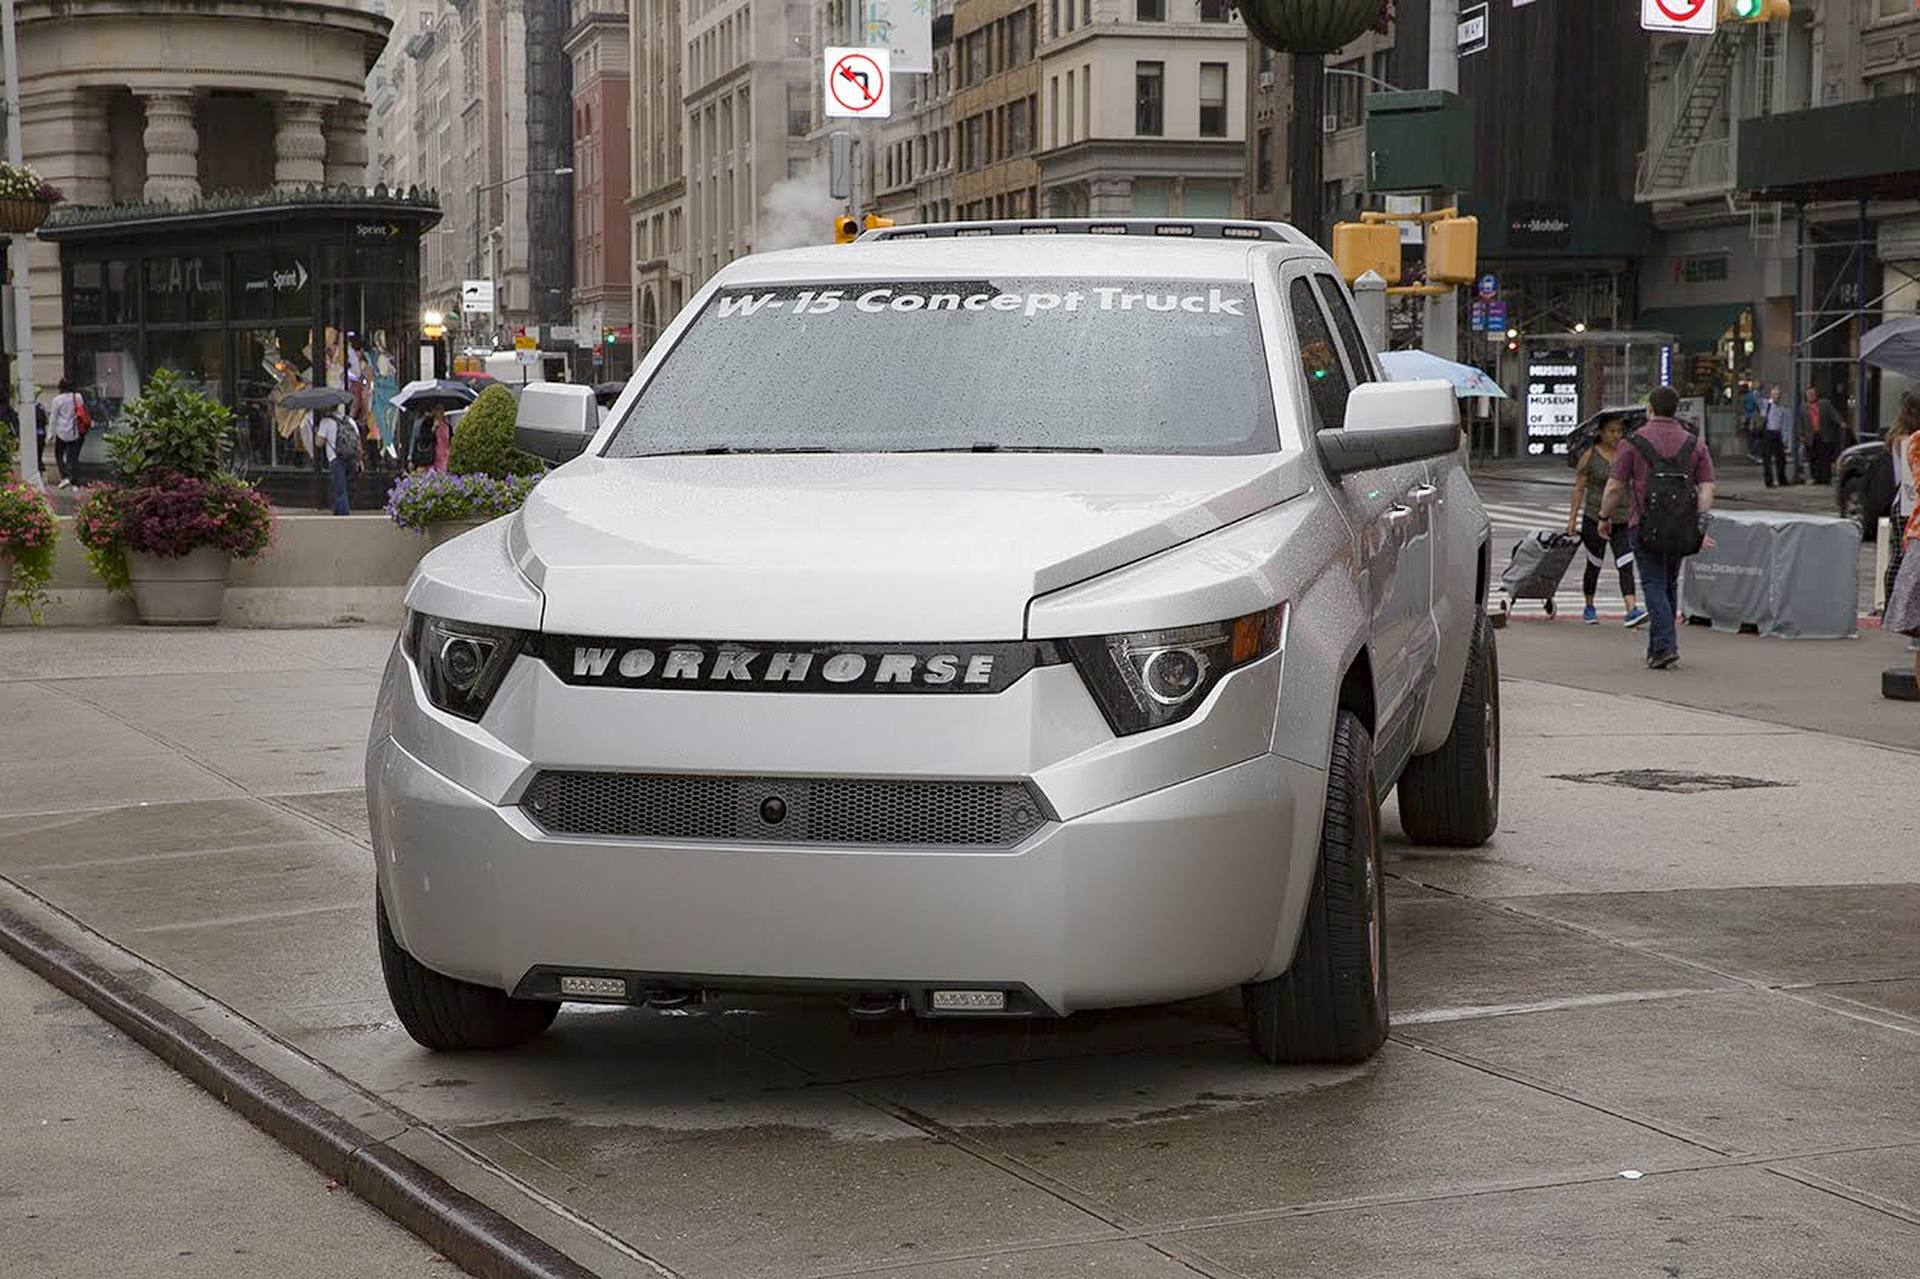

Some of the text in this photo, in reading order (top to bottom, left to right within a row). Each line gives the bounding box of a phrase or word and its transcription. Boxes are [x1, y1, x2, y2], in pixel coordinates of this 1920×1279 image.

[356, 224, 387, 236] Sprint
[273, 270, 297, 292] Sprint
[718, 288, 1244, 318] W-15 Concept Truck
[1529, 365, 1577, 377] MUSEUM
[1528, 383, 1576, 394] OF SEX
[1530, 397, 1575, 405] MUSEUM
[1530, 415, 1574, 423] OF SEX
[1528, 443, 1569, 455] OF SE
[573, 647, 995, 685] WORKHORSE
